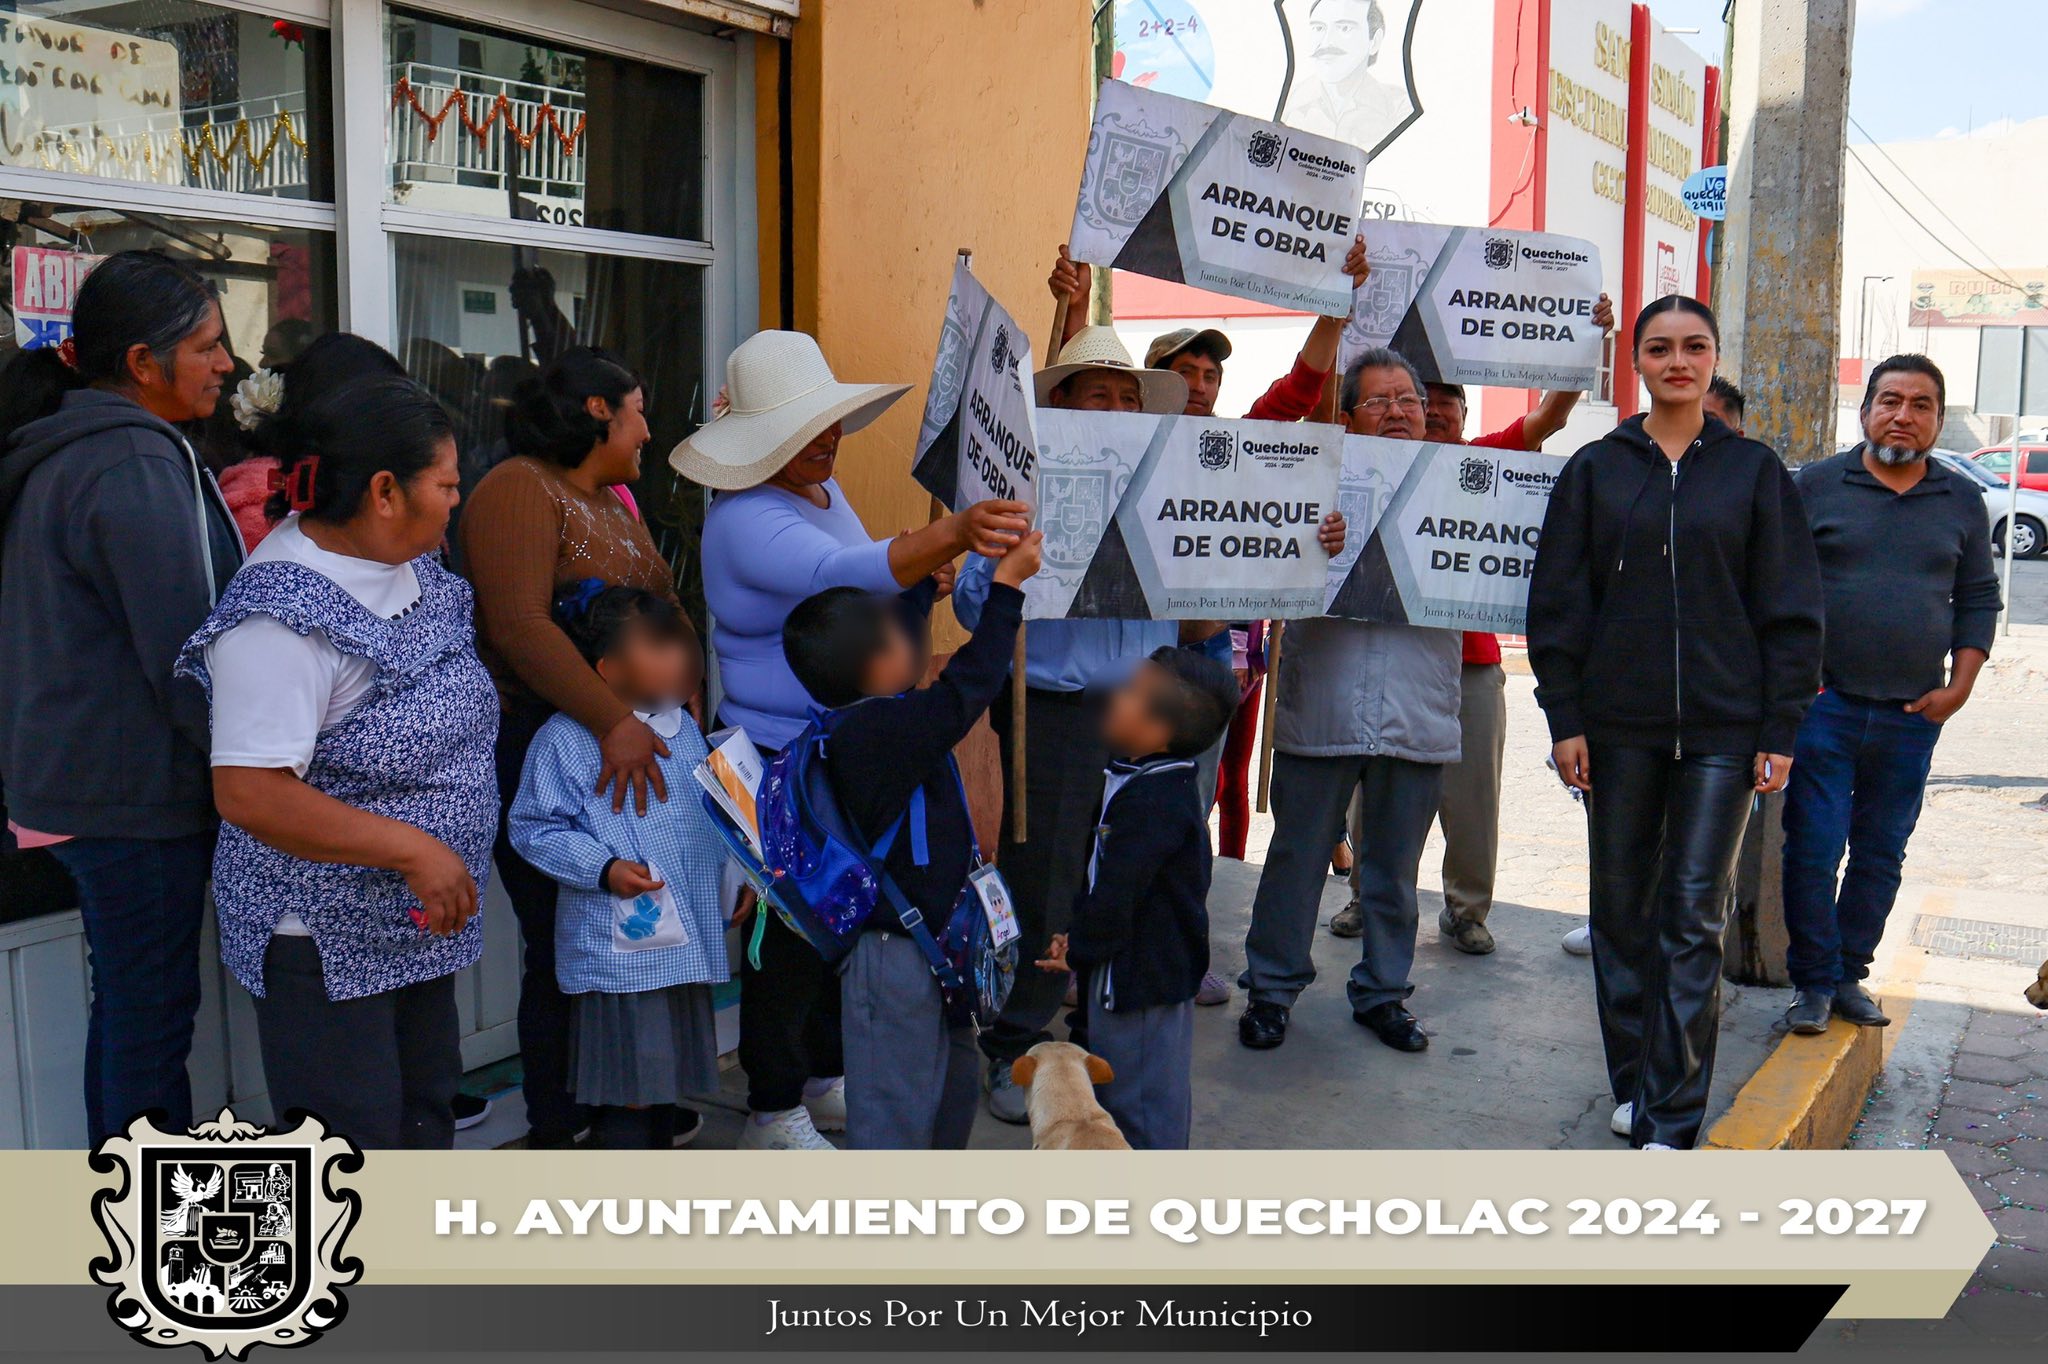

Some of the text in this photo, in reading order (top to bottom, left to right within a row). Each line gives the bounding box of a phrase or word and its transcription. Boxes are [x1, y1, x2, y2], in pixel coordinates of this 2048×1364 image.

[1595, 21, 1632, 83] SAN
[1289, 148, 1356, 174] Quecholac
[1684, 190, 1726, 201] QUECHO
[1706, 178, 1725, 190] Ve
[1201, 182, 1351, 236] ARRANQUE
[1692, 200, 1726, 211] 24911
[1211, 216, 1326, 263] DE OBRA
[1522, 247, 1588, 262] Quecholac
[1199, 270, 1341, 309] Juntos Por Un Mejor Municipio
[1448, 289, 1591, 318] ARRANQUE
[1461, 318, 1575, 342] DE OBRA
[1454, 366, 1590, 385] Juntos Por Un Mejor Municipio
[970, 388, 1035, 482] ARRANQUE
[1242, 440, 1320, 455] Quecholac
[967, 432, 1016, 501] DE OBRA
[1502, 469, 1559, 484] Quecho
[1157, 498, 1320, 528] ARRANQUE
[1415, 516, 1542, 551] ARRANQ
[1173, 535, 1301, 558] DE OBRA
[1431, 549, 1535, 578] DE OBR
[1167, 597, 1316, 612] Juntos Por Un Mejor Municipio
[1424, 606, 1455, 618] Juntos
[1457, 608, 1474, 620] Por
[1478, 610, 1494, 622] Un
